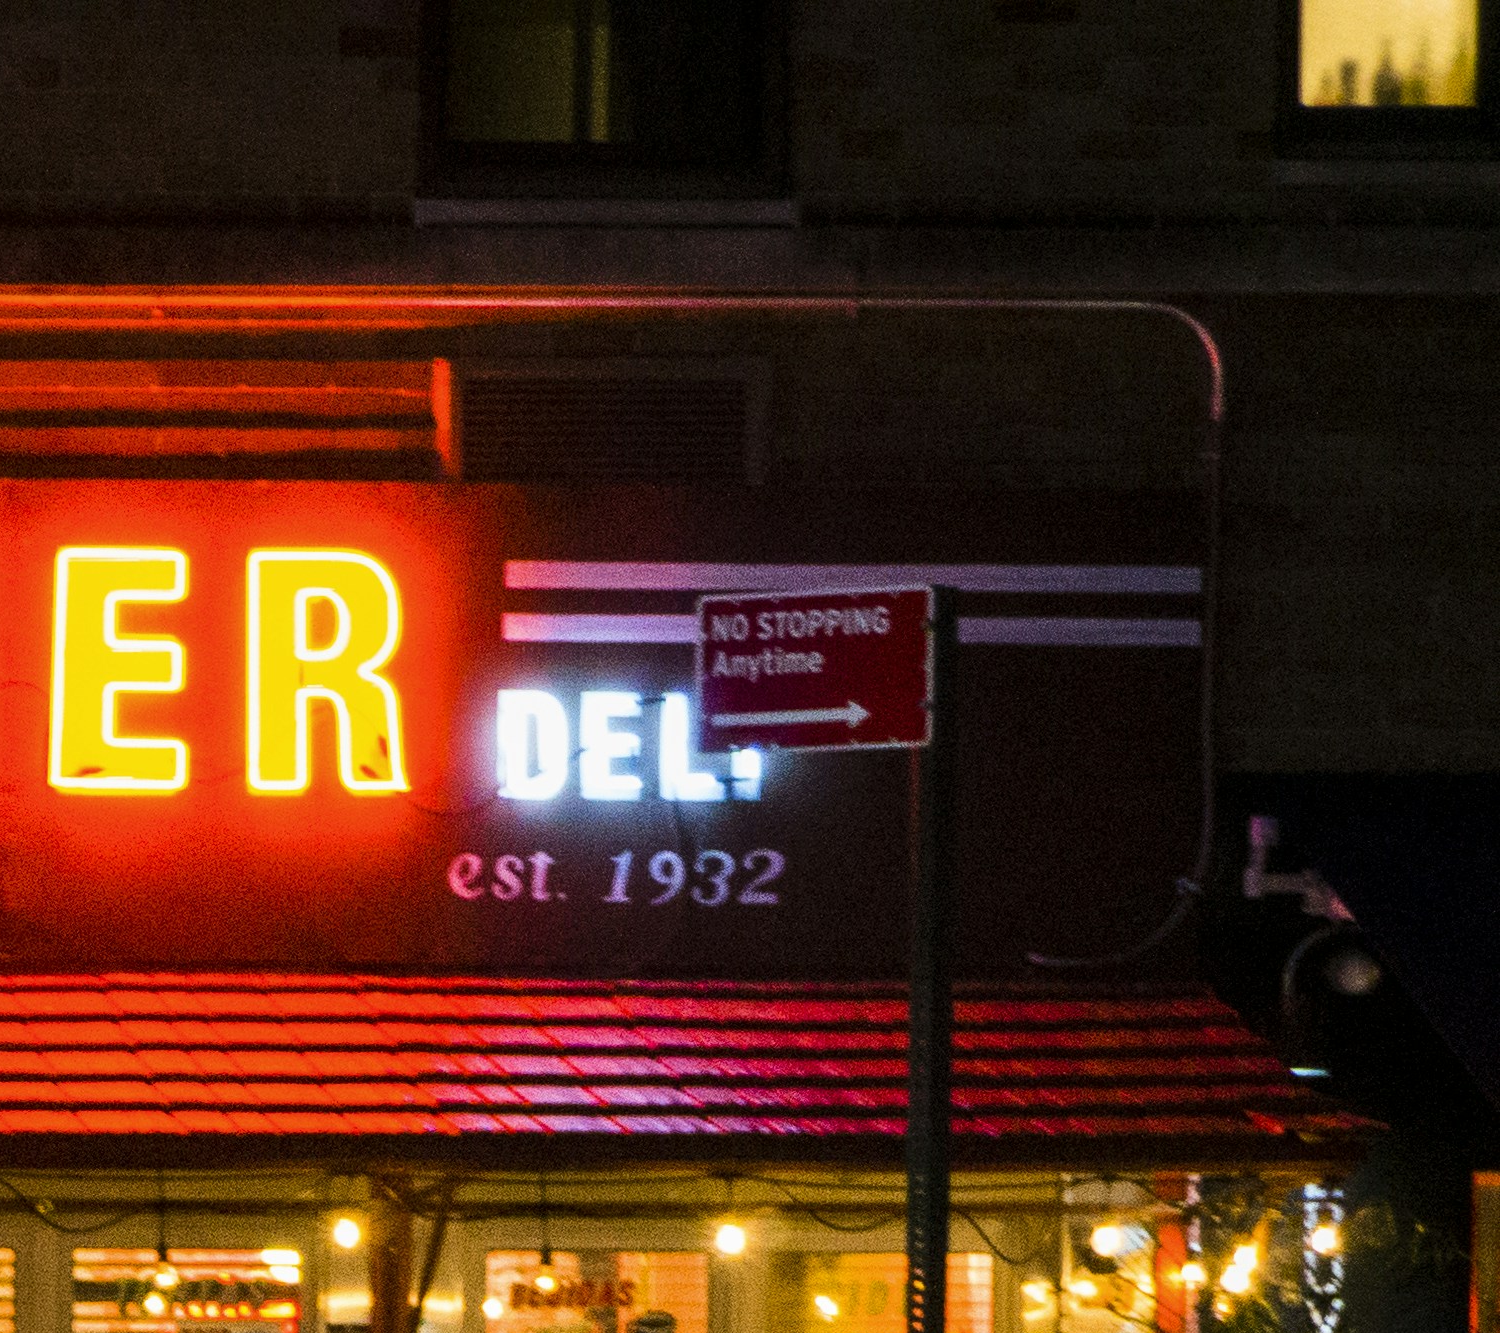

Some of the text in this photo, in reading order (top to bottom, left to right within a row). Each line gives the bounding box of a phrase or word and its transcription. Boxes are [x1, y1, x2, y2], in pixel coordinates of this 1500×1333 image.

[711, 607, 890, 641] NO STOPPING
[712, 648, 825, 681] Anytime
[447, 848, 787, 906] est. 1932
